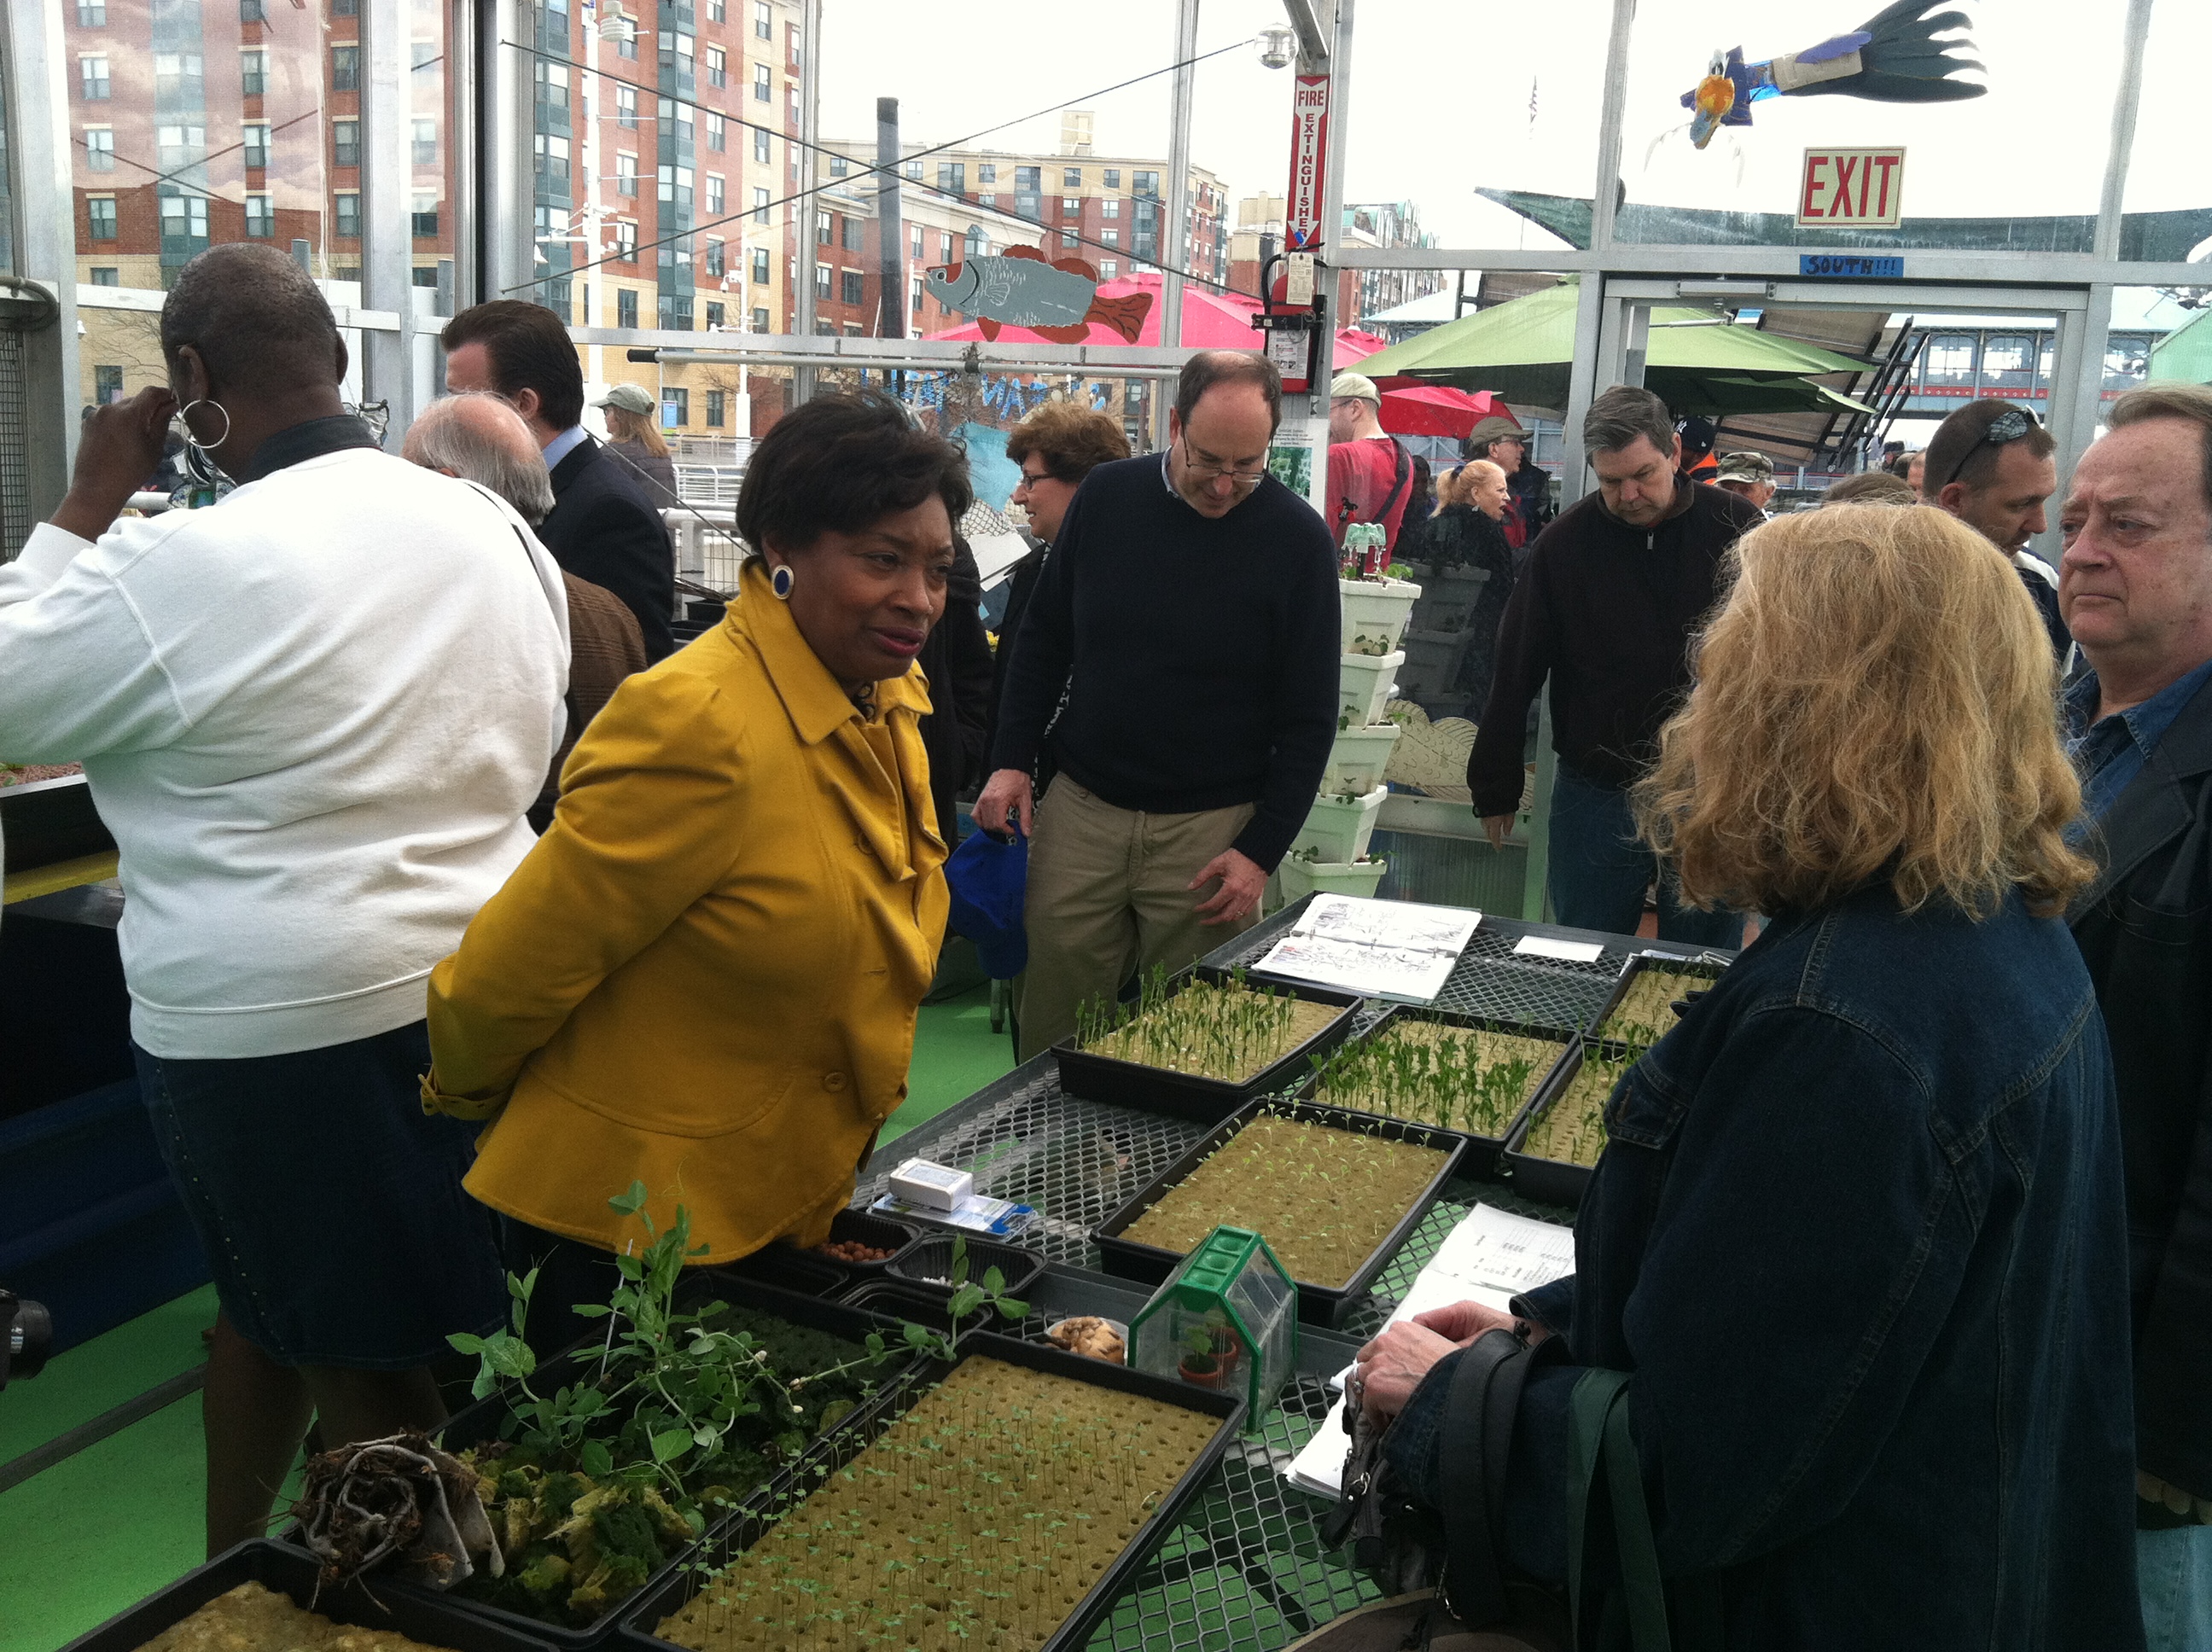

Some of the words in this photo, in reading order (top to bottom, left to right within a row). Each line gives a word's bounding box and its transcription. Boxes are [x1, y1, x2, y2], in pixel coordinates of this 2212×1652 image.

[1298, 90, 1324, 107] FIRE
[1298, 113, 1315, 238] EXTINGUISHER
[1803, 156, 1900, 217] EXIT
[1806, 256, 1896, 275] SOUTH!!!
